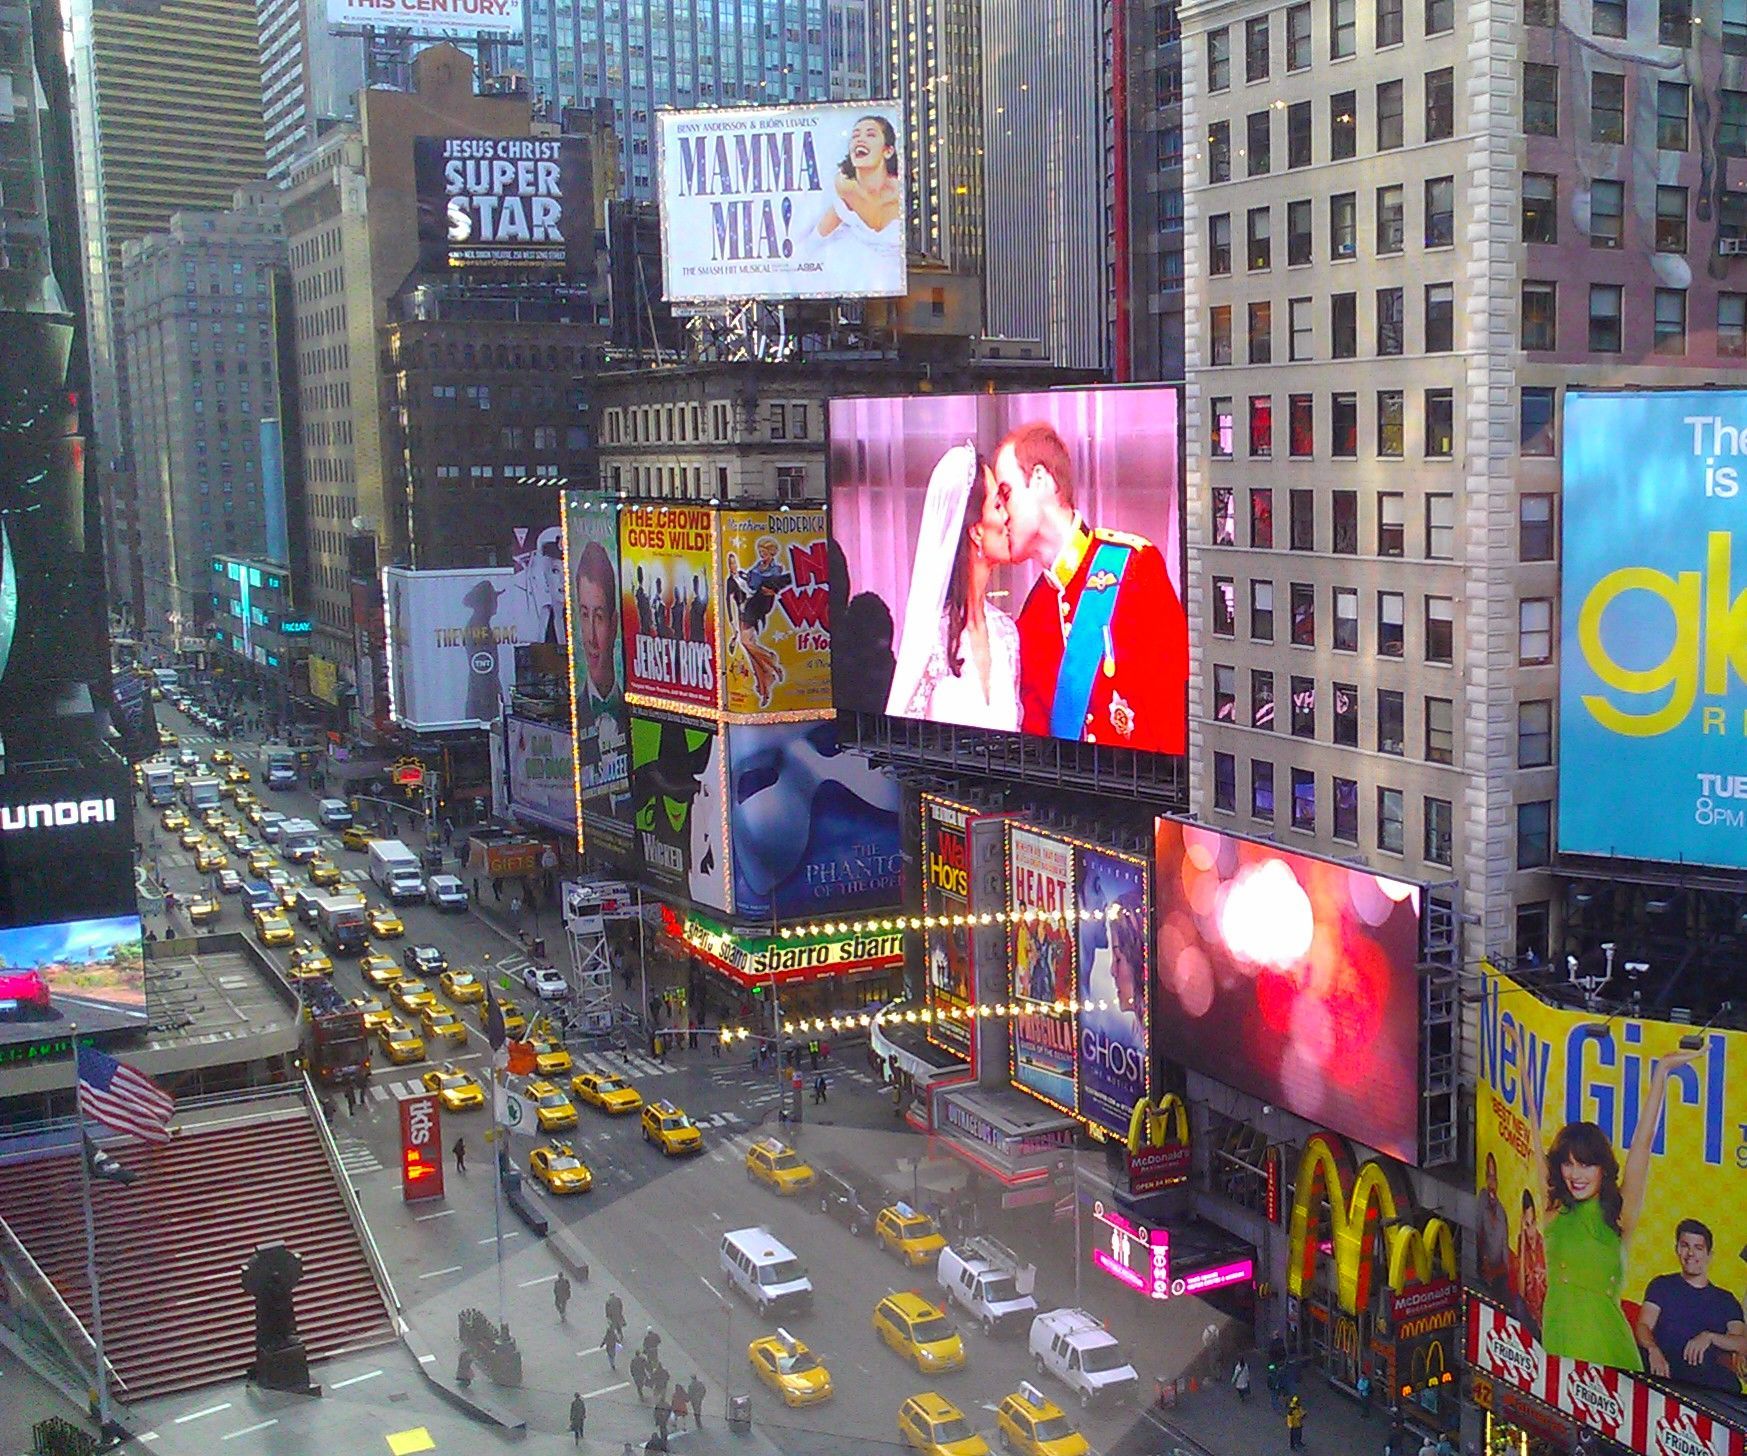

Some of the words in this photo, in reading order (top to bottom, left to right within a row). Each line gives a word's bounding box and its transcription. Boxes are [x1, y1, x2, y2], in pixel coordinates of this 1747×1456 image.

[443, 140, 494, 158] JESUS
[497, 141, 561, 158] CHRIST
[678, 131, 822, 196] MAMMA
[445, 161, 562, 197] SUPER
[447, 196, 565, 242] STAR
[710, 196, 794, 261] MIA!
[1705, 456, 1739, 498] is
[627, 509, 653, 527] THE
[657, 510, 711, 530] CROWD
[768, 515, 825, 534] BRODERICK
[628, 528, 665, 549] GOES
[668, 531, 710, 552] WILD!
[798, 633, 811, 650] If
[634, 634, 677, 684] JERSEY
[679, 640, 713, 690] BOYS
[1695, 797, 1744, 827] 8PM
[851, 844, 880, 857] THE
[1016, 866, 1067, 914] HEART
[754, 944, 830, 973] sbarro
[839, 934, 903, 961] sbarr
[1081, 1027, 1145, 1083] GHOST
[1480, 971, 1550, 1130] New
[1565, 1022, 1726, 1165] Girl
[409, 1100, 434, 1145] tkts
[1131, 1149, 1190, 1168] McDonald's
[1394, 1284, 1458, 1310] McDonald's
